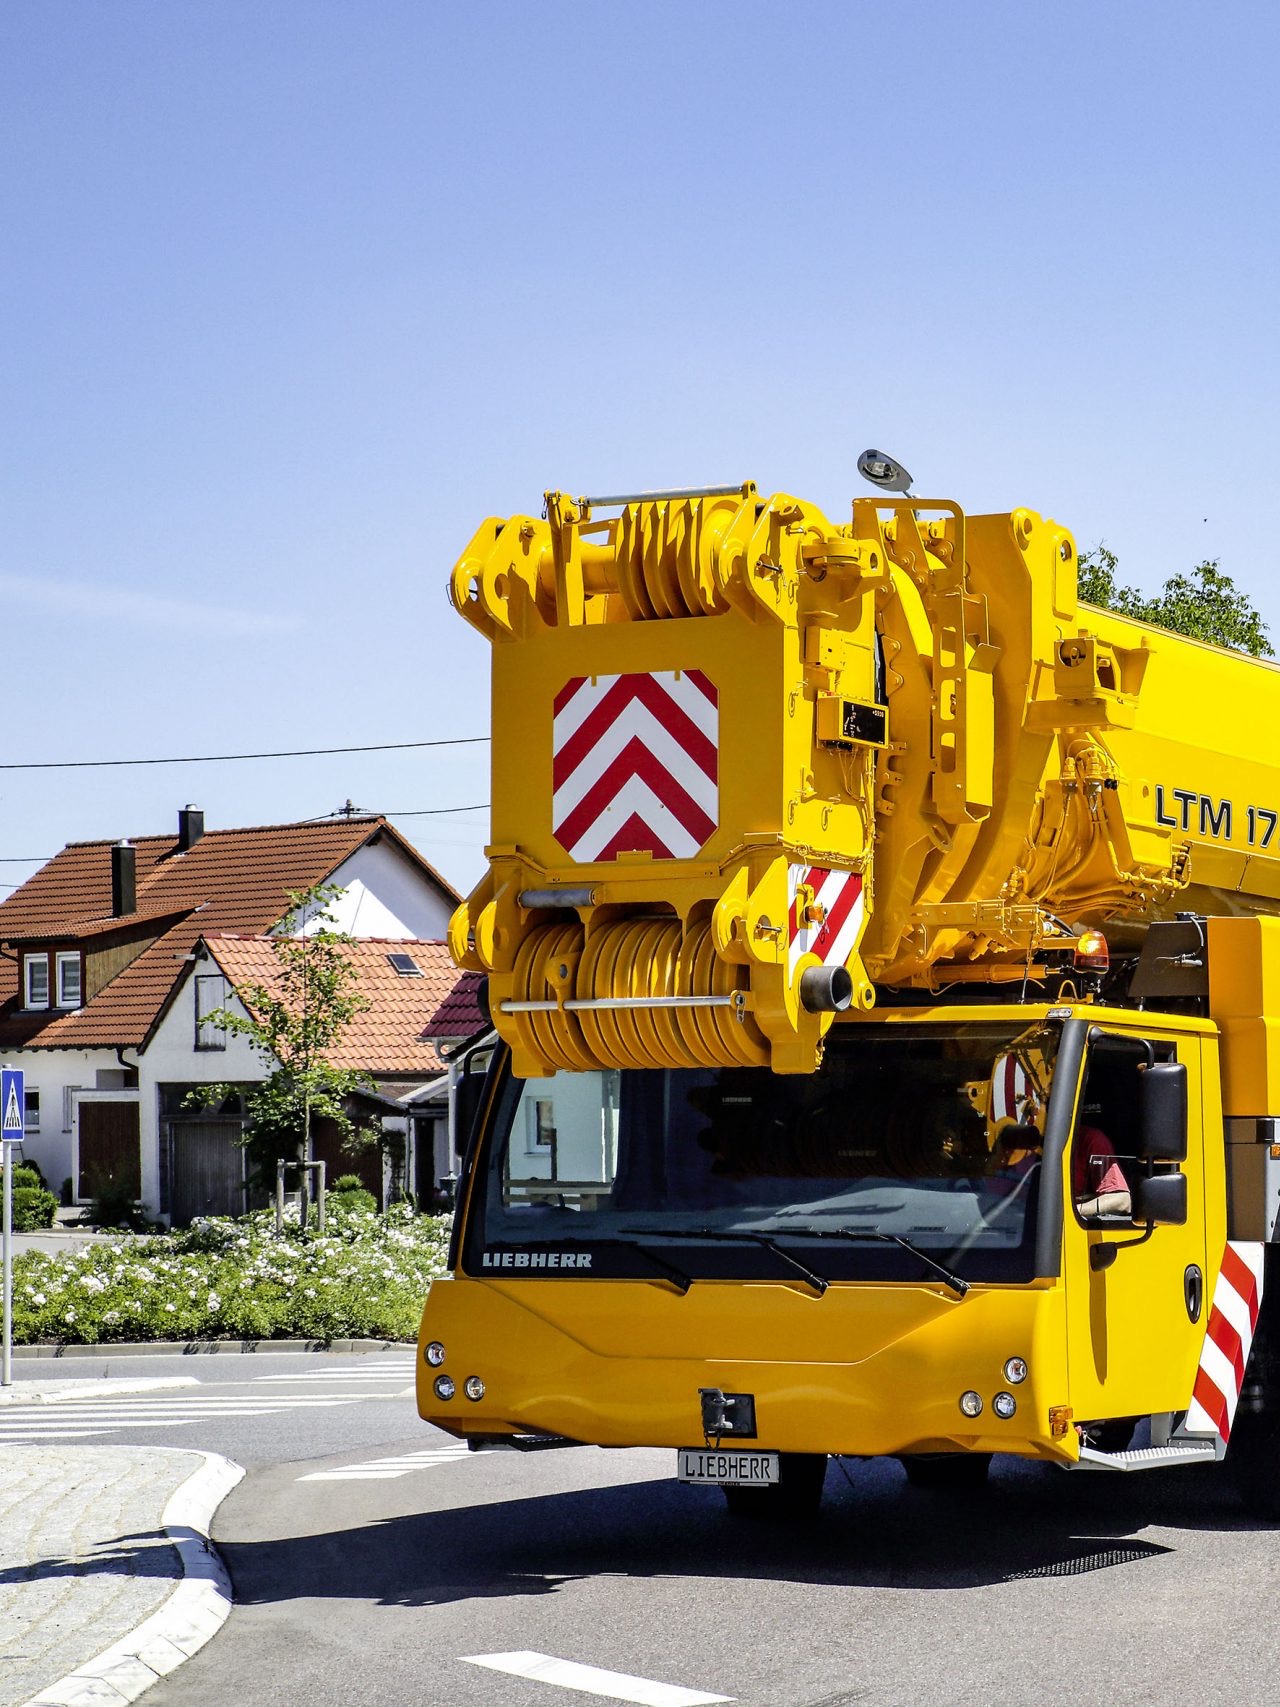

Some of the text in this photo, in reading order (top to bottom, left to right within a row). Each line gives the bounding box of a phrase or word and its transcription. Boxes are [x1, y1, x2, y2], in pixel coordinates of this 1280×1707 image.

[1155, 784, 1232, 841] LTM
[482, 1253, 592, 1268] LIEBHERR
[685, 1454, 771, 1479] LIEBHERR
